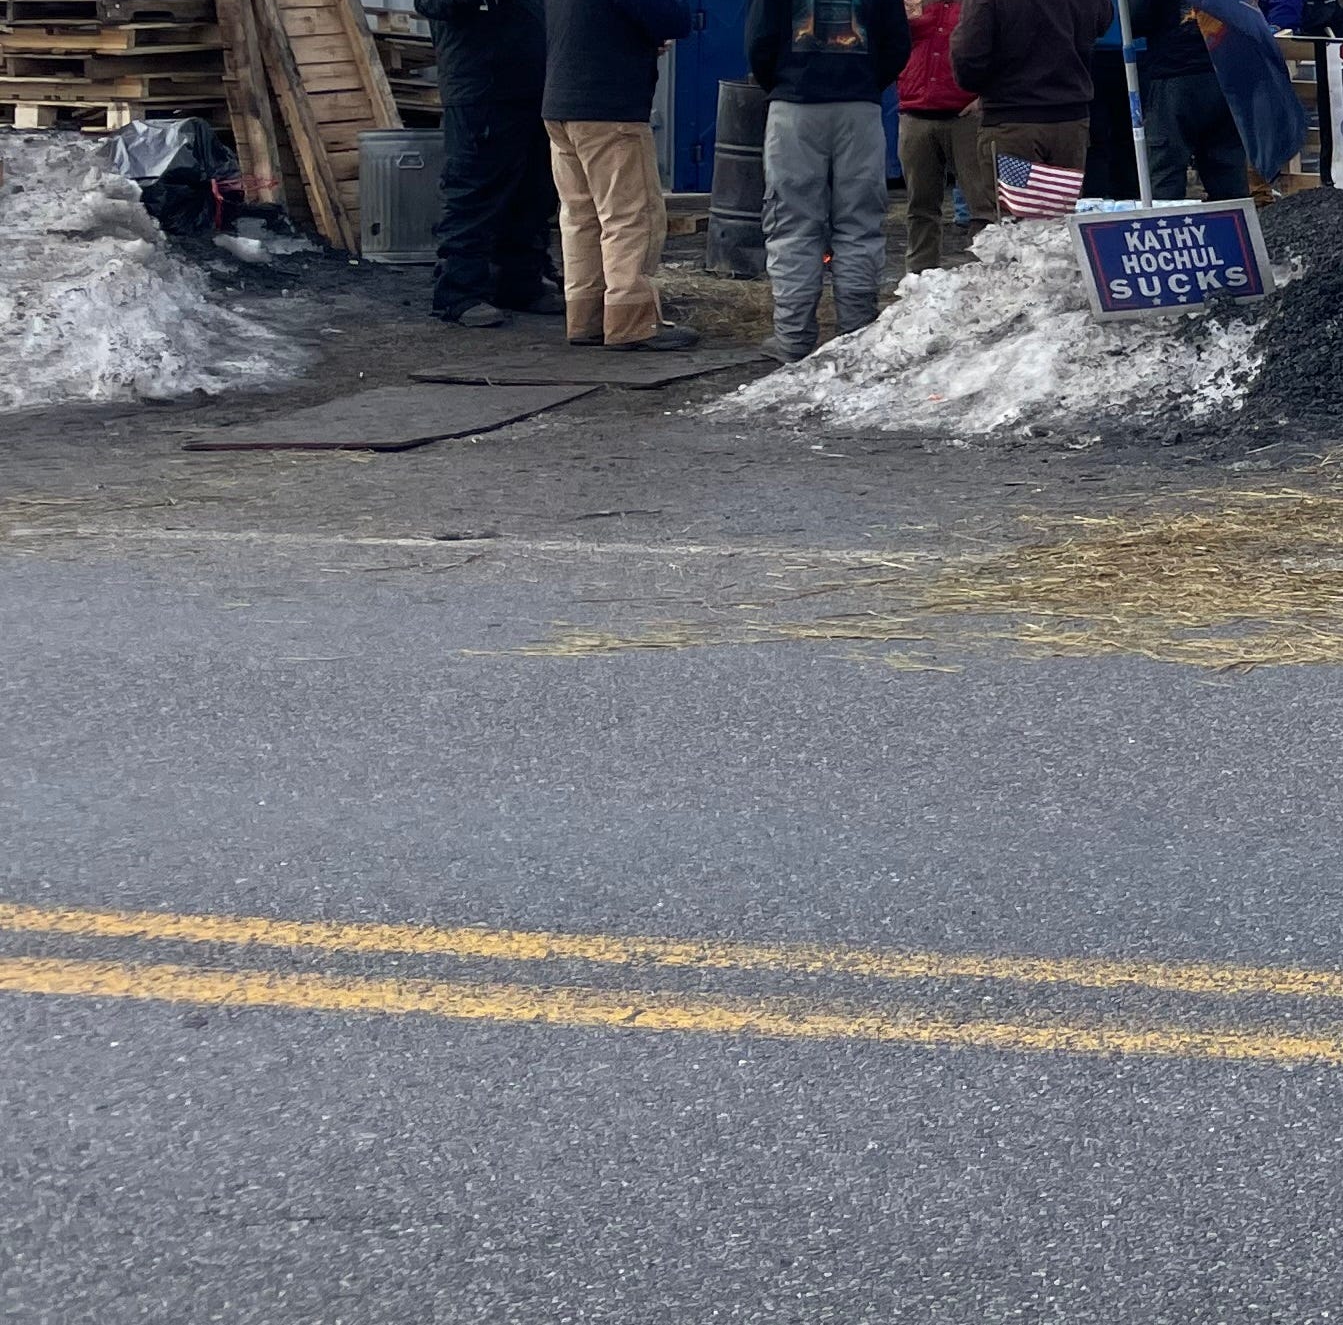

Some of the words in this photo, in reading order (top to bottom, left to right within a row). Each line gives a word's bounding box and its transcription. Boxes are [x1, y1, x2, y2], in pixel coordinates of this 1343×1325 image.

[1124, 224, 1206, 253] KATHY
[1121, 246, 1225, 275] HOCHUL
[1109, 266, 1248, 300] SUCKS
